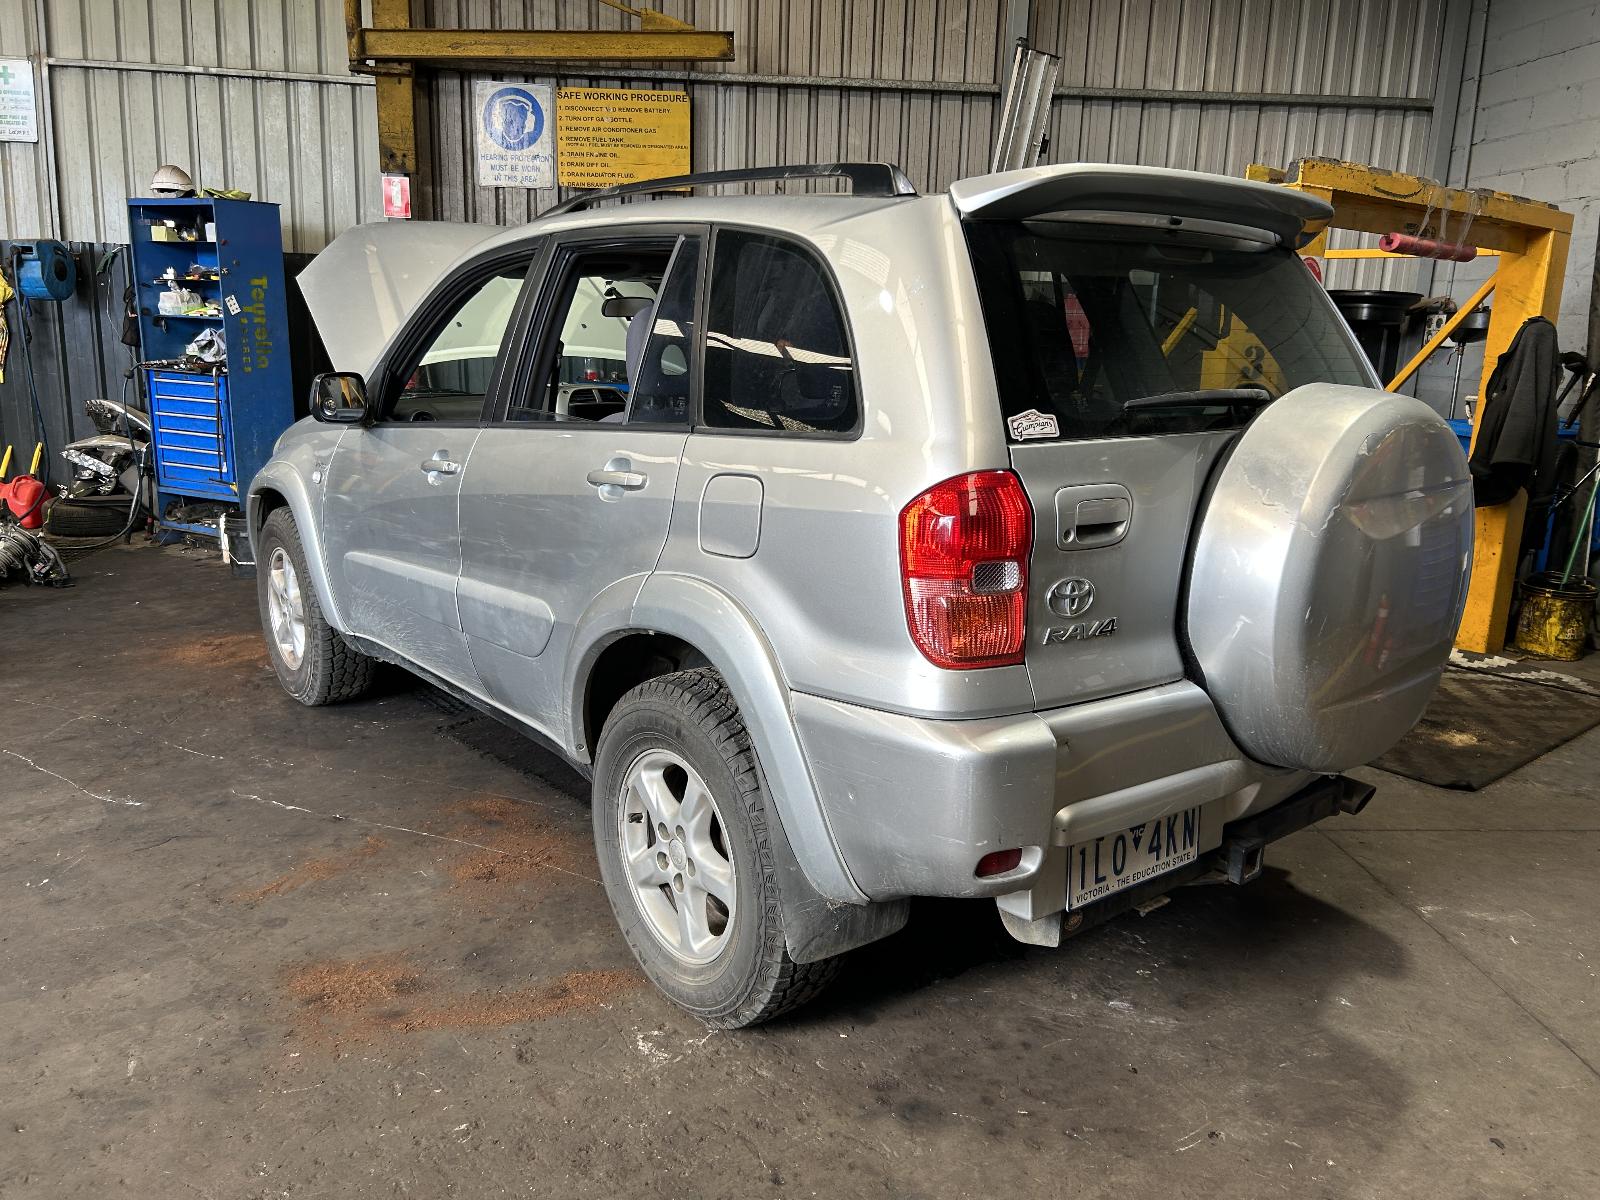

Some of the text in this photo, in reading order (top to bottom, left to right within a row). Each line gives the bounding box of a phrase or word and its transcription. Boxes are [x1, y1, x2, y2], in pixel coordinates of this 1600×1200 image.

[557, 91, 688, 103] SAFE WORKING PROCEDURE
[480, 153, 550, 163] HEARING PROTECTION
[510, 164, 519, 172] BE
[521, 165, 541, 173] WORN
[494, 174, 538, 183] IN THIS AREA
[1013, 421, 1053, 439] Grampians
[1042, 616, 1118, 645] RAV4
[1076, 884, 1110, 904] VICTORIA
[1116, 875, 1131, 889] THE
[1132, 860, 1171, 882] EDUCATION
[1172, 851, 1191, 867] STATE
